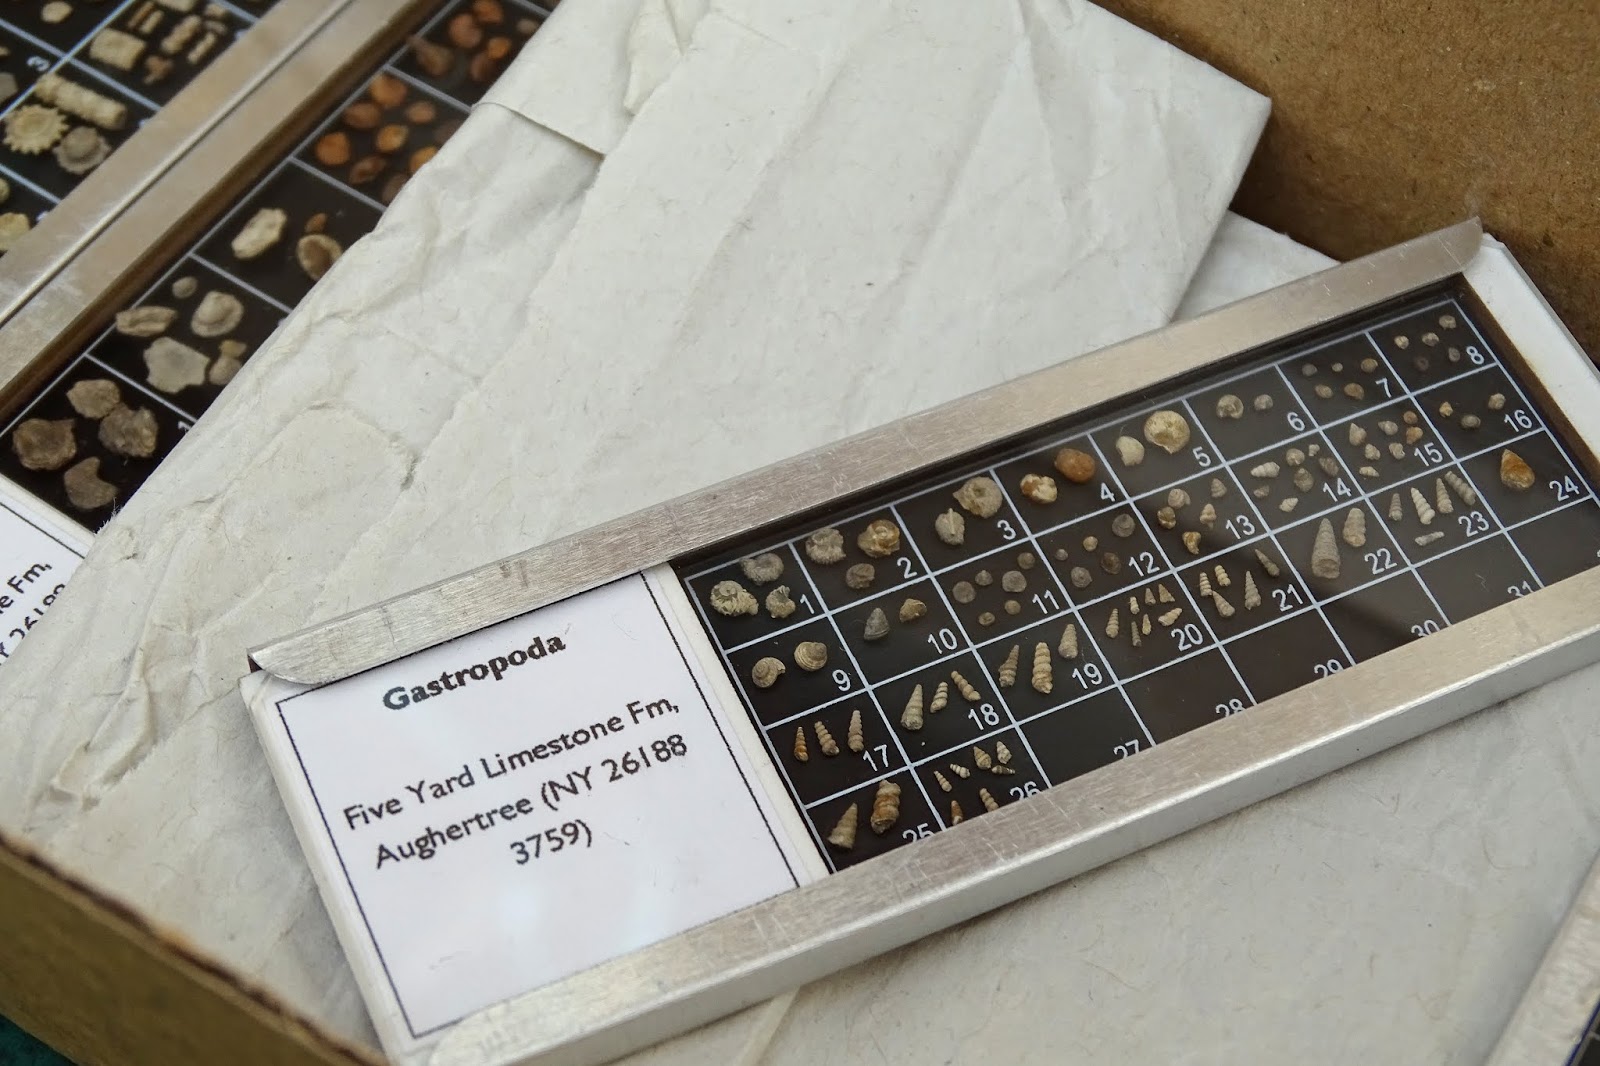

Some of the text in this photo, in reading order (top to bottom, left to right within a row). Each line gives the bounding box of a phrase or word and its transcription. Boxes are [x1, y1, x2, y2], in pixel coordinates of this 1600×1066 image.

[1466, 346, 1485, 365] 8
[1376, 378, 1393, 398] 7
[1287, 412, 1306, 431] 6
[1504, 410, 1532, 432] 16
[1193, 446, 1211, 468] 5
[1414, 442, 1442, 466] 15
[1101, 483, 1116, 503] 4
[1323, 477, 1351, 502] 14
[1549, 476, 1579, 501] 24
[997, 519, 1017, 540] 3
[1226, 515, 1255, 539] 13
[1458, 511, 1489, 537] 23
[896, 557, 918, 579] 2
[1129, 552, 1160, 576] 12
[1364, 548, 1397, 574] 22
[7, 563, 52, 594] Fm,
[800, 593, 815, 614] 1
[1032, 589, 1059, 614] 11
[1272, 584, 1303, 611] 21
[928, 628, 958, 654] 10
[1171, 624, 1202, 651] 20
[382, 635, 566, 710] Gastropoda
[832, 669, 851, 691] 9
[1072, 663, 1102, 689] 19
[968, 703, 999, 730] 18
[343, 698, 679, 830] Five Yard Limestone Fm,
[862, 744, 889, 771] 17
[376, 734, 687, 869] Aughertree (NY 26188
[510, 820, 592, 865] 3759)
